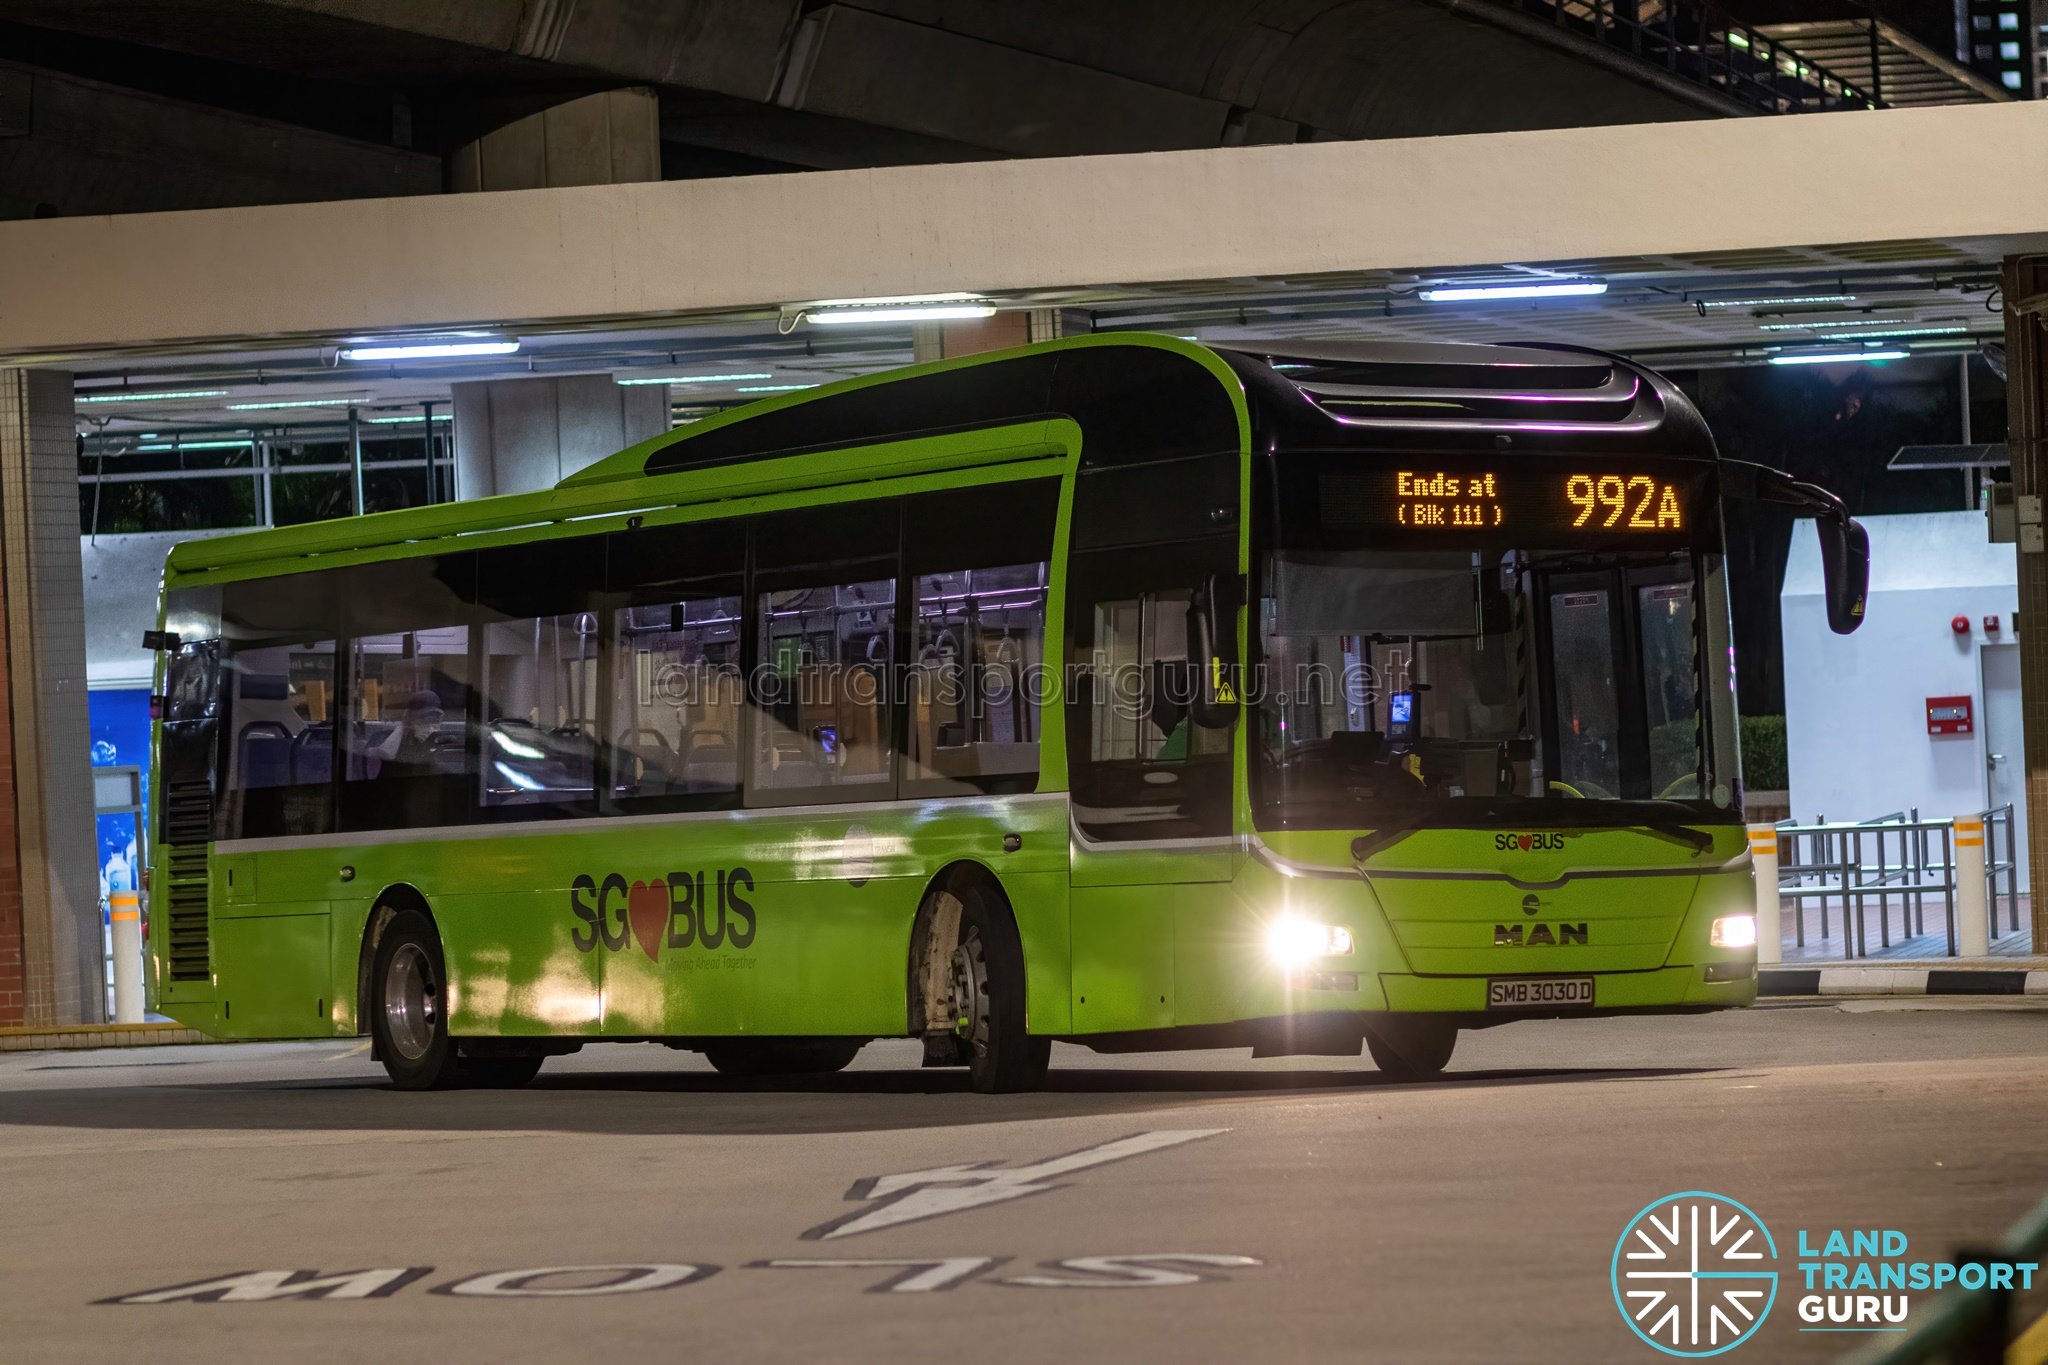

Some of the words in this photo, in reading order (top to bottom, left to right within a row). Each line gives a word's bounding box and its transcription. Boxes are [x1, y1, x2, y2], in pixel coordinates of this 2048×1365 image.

[1398, 472, 1460, 496] Ends
[1468, 473, 1496, 497] at
[1567, 475, 1681, 528] 992A
[1494, 923, 1588, 945] MAN
[723, 955, 757, 972] Together
